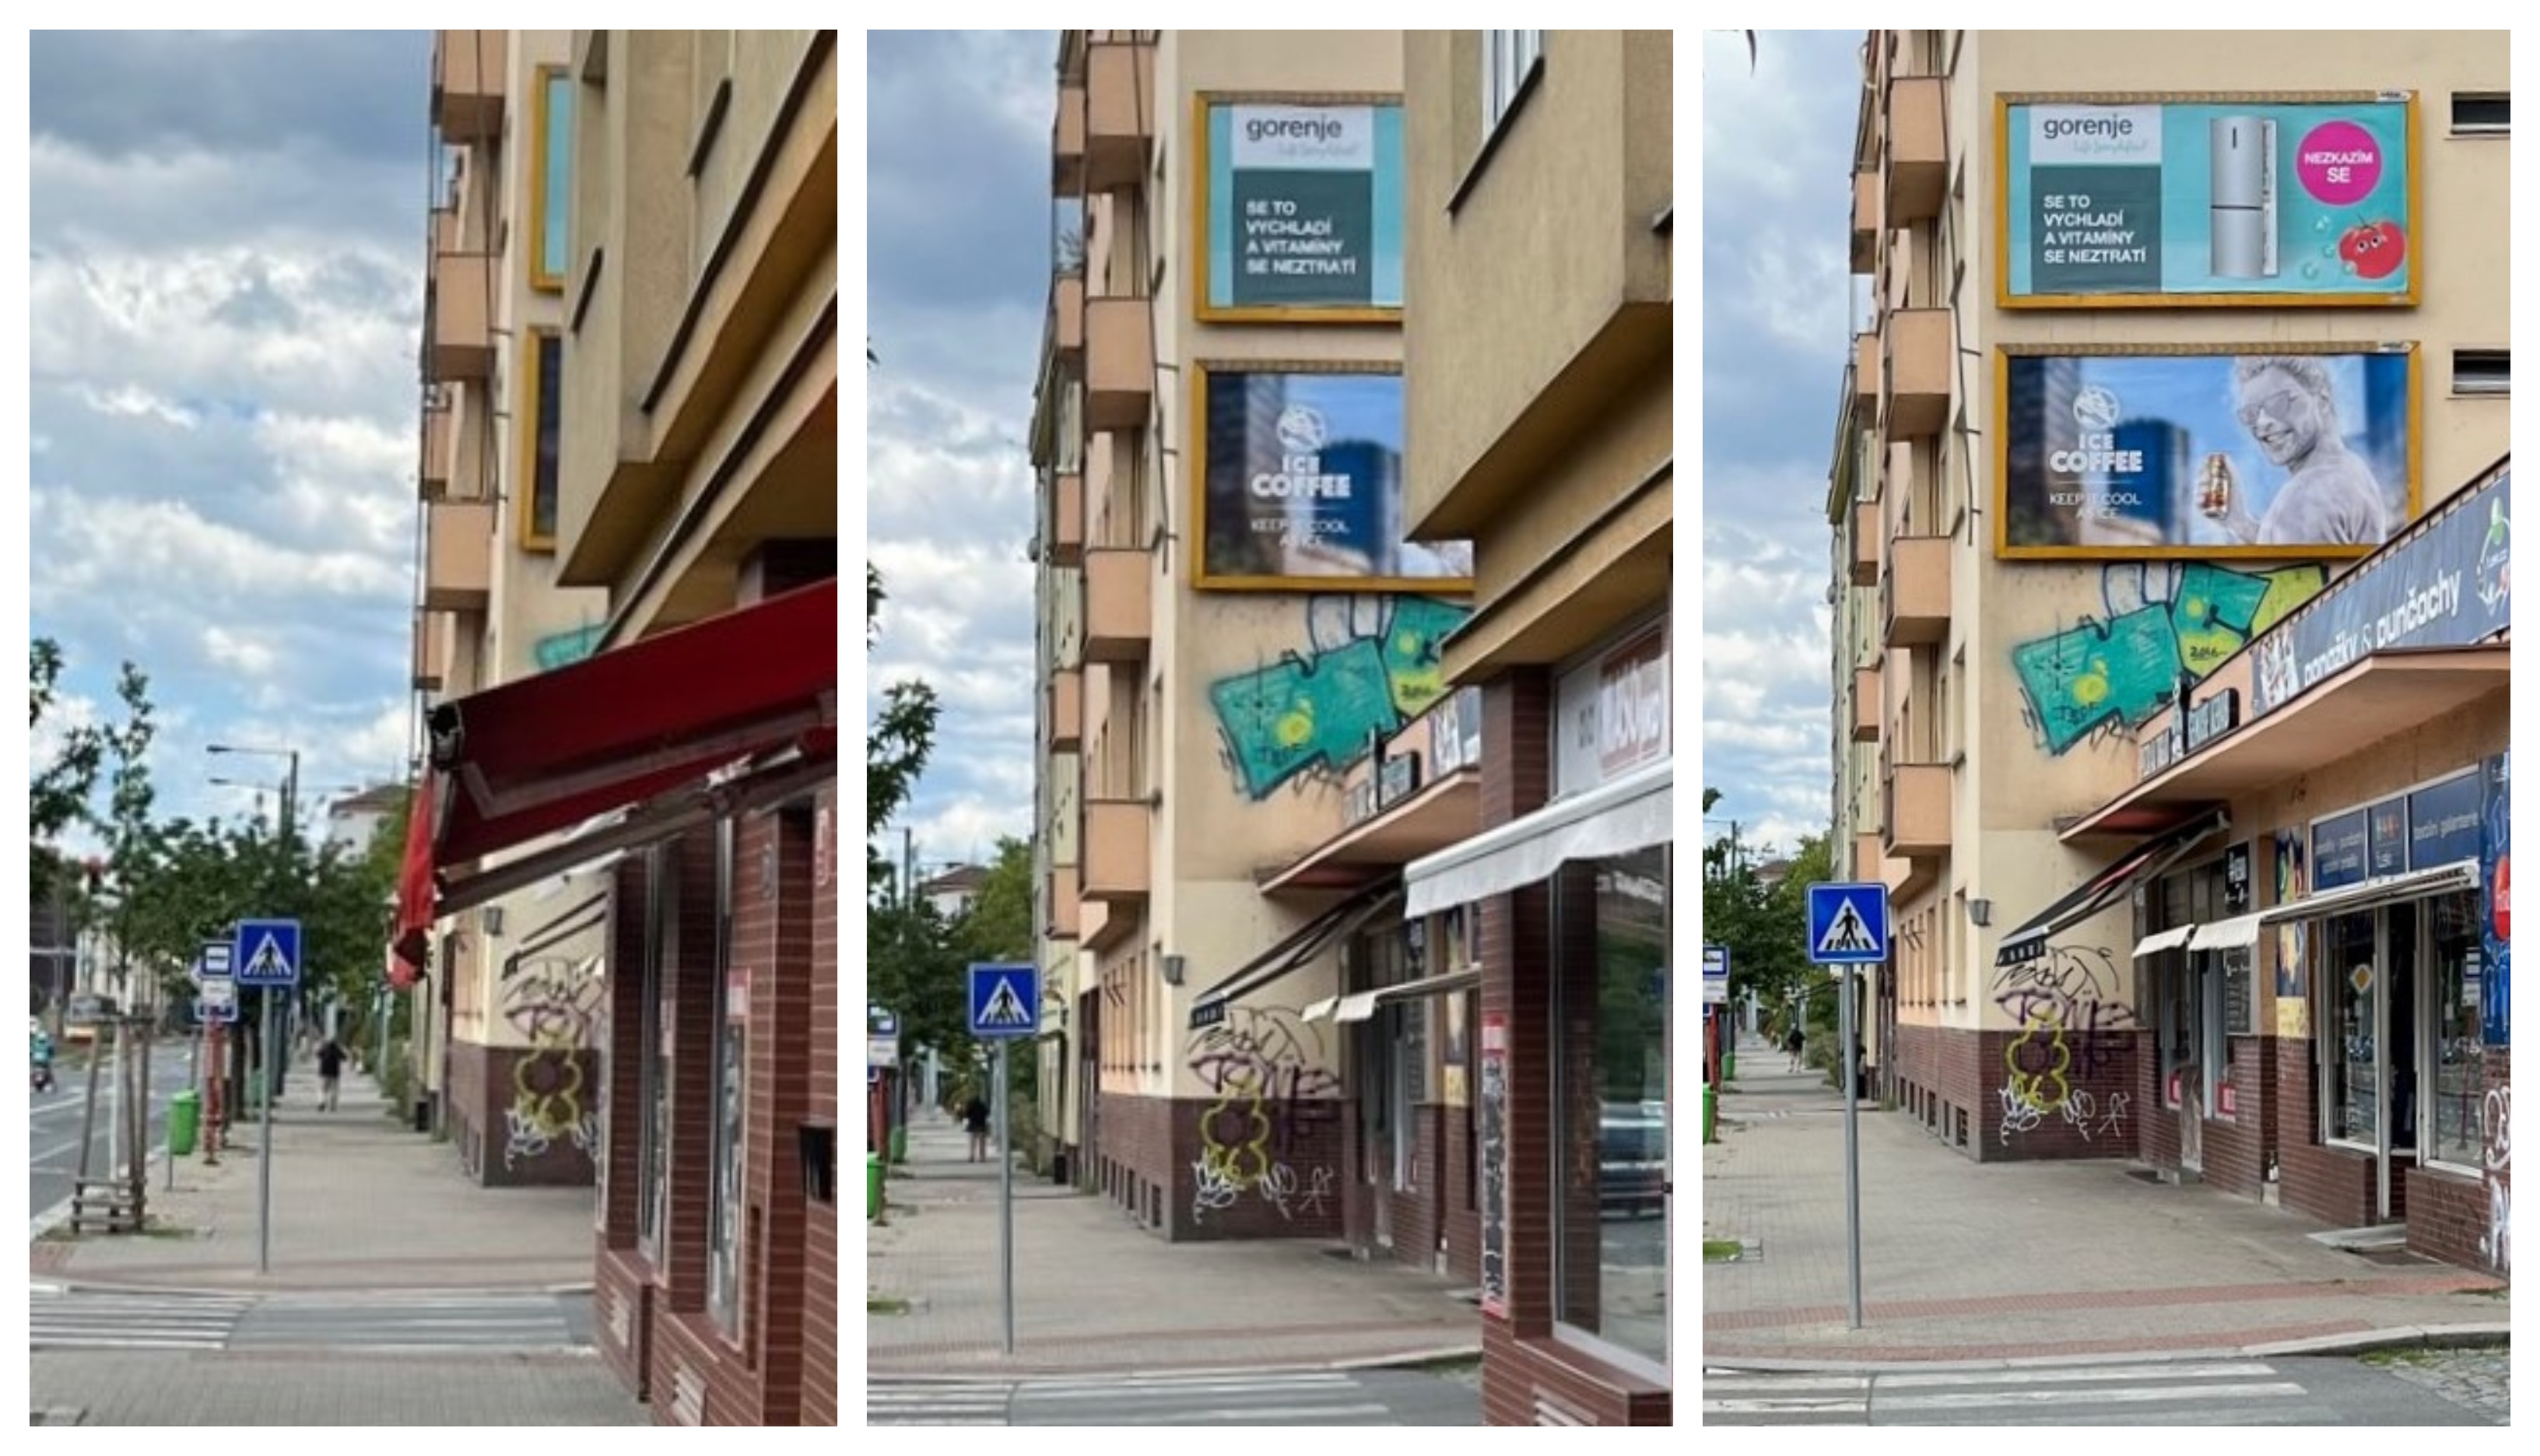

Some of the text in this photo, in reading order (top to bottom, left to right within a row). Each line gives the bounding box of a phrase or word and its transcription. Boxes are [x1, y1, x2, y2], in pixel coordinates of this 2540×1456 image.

[1246, 114, 1342, 141] gorenje
[2044, 114, 2133, 139] gorenje
[2304, 149, 2373, 165] NEZKAZÍM
[2327, 168, 2351, 183] SE
[1246, 200, 1296, 216] SE TO
[2044, 195, 2090, 209] SE TO
[1246, 217, 1331, 236] VYCHLADÍ
[2044, 210, 2123, 227] VYCHLADÍ
[1246, 236, 1344, 254] A VITAMÍNY
[2044, 229, 2135, 245] A VITAMÍNY
[2044, 246, 2147, 264] SE NEZTRATÍ
[1246, 258, 1356, 275] SE NEZTRATÍ
[2079, 433, 2114, 450] ICE
[1282, 456, 1320, 473] ICE
[2050, 451, 2143, 473] COFFEE
[1251, 474, 1352, 497] COFFEE
[2100, 493, 2142, 505] COOL
